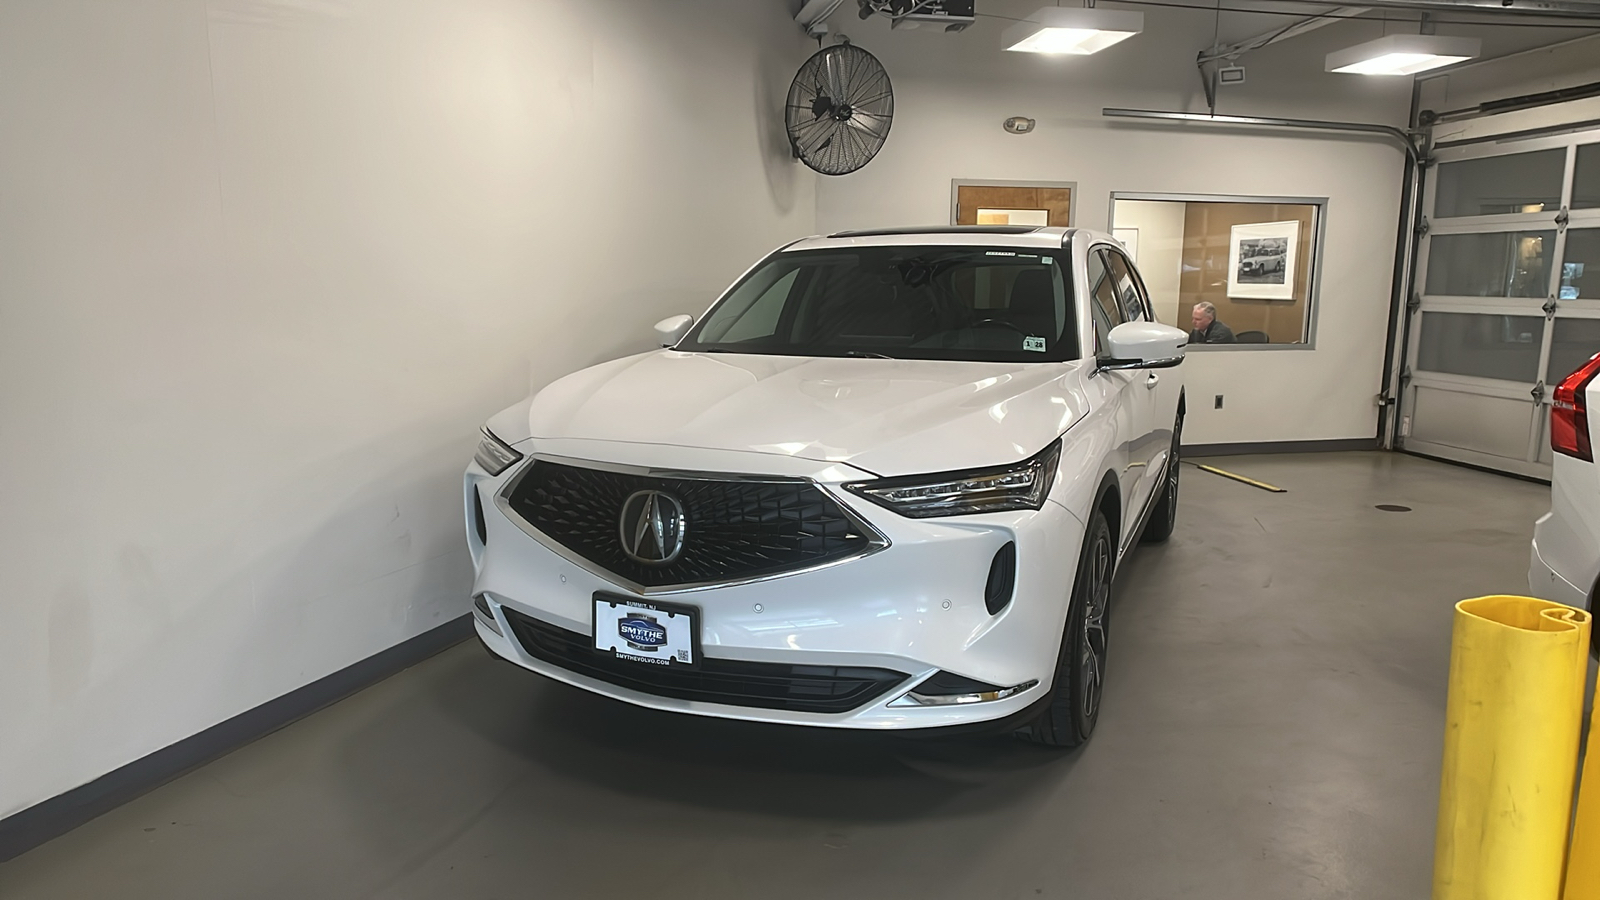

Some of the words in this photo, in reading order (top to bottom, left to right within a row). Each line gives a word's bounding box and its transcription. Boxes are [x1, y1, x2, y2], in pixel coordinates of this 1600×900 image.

[621, 625, 664, 640] SMYTHE
[630, 634, 656, 643] VOLVO
[615, 652, 670, 666] SMYTHEVOLVO.COM
